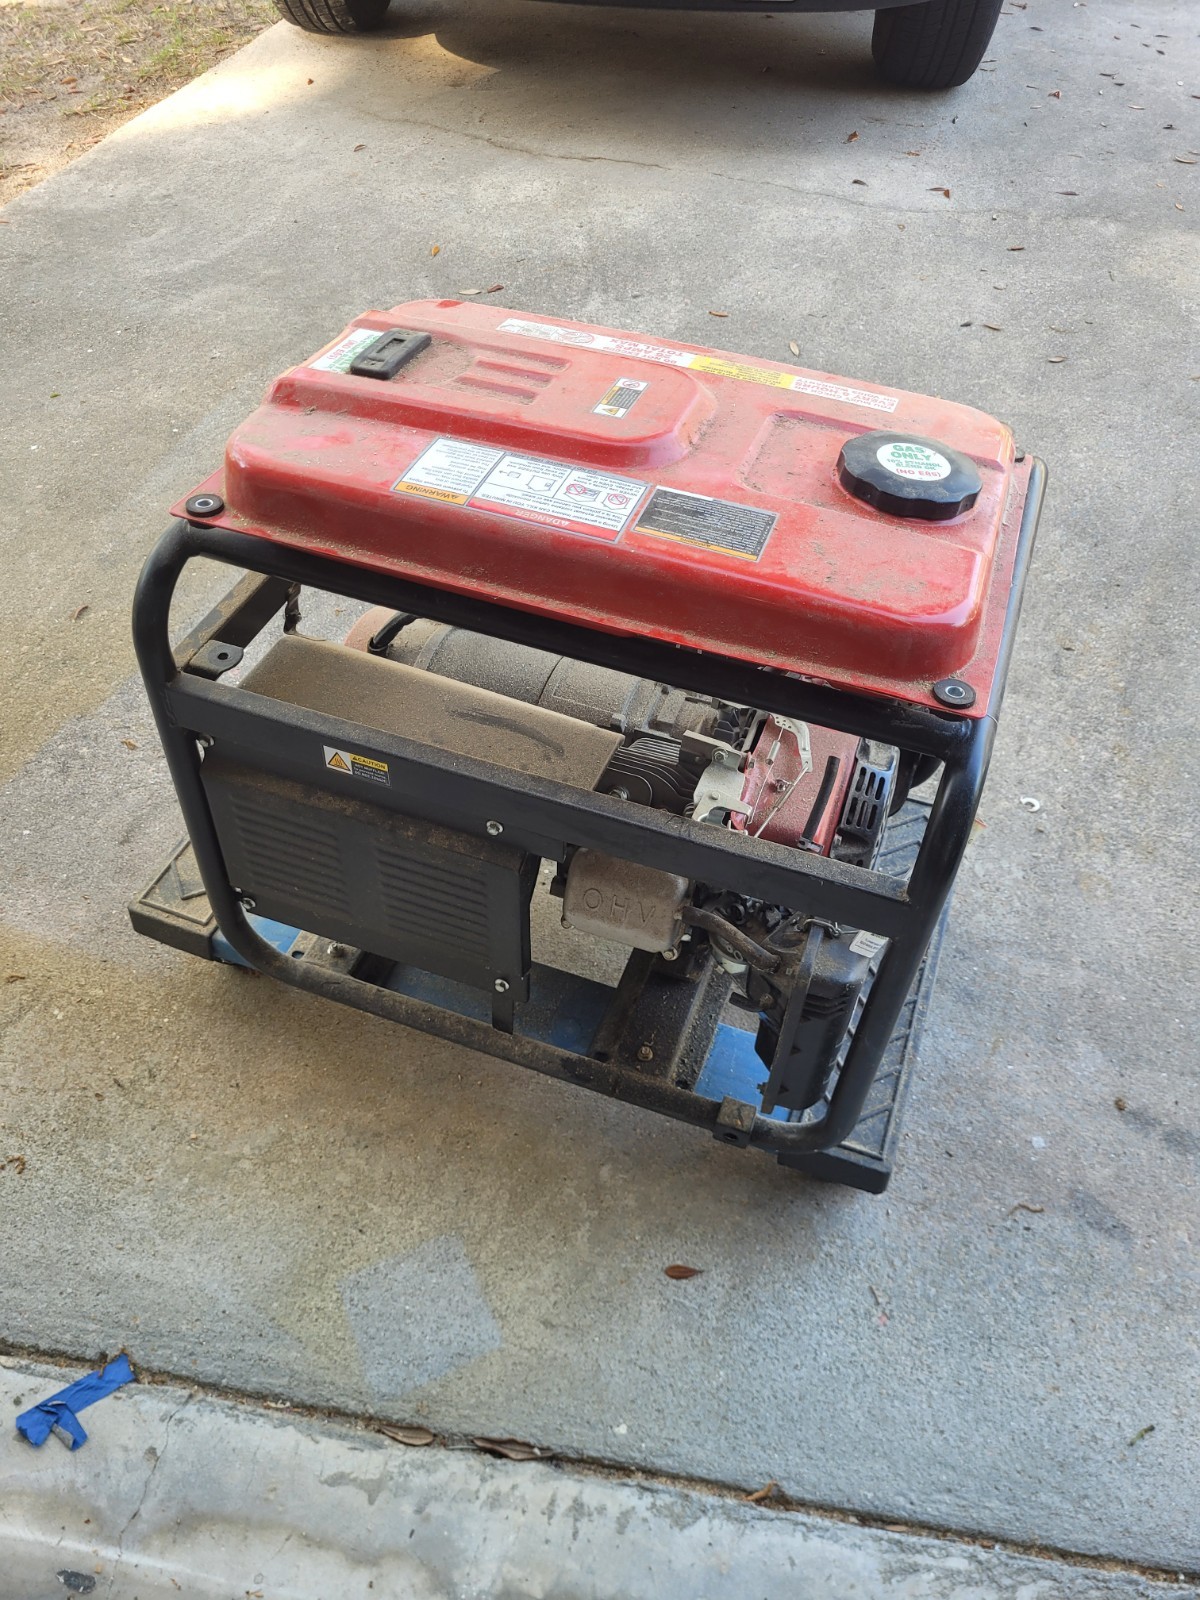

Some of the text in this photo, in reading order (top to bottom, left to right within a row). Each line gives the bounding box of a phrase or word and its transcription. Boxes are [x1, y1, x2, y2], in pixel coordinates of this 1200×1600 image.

[614, 344, 652, 354] AMPS
[641, 345, 684, 356] TOTAL
[892, 444, 925, 453] GAS
[890, 451, 931, 461] ONLY
[404, 484, 451, 498] WARNING
[513, 509, 560, 524] DANGER
[357, 757, 385, 769] CAUTION
[583, 888, 656, 927] OHV
